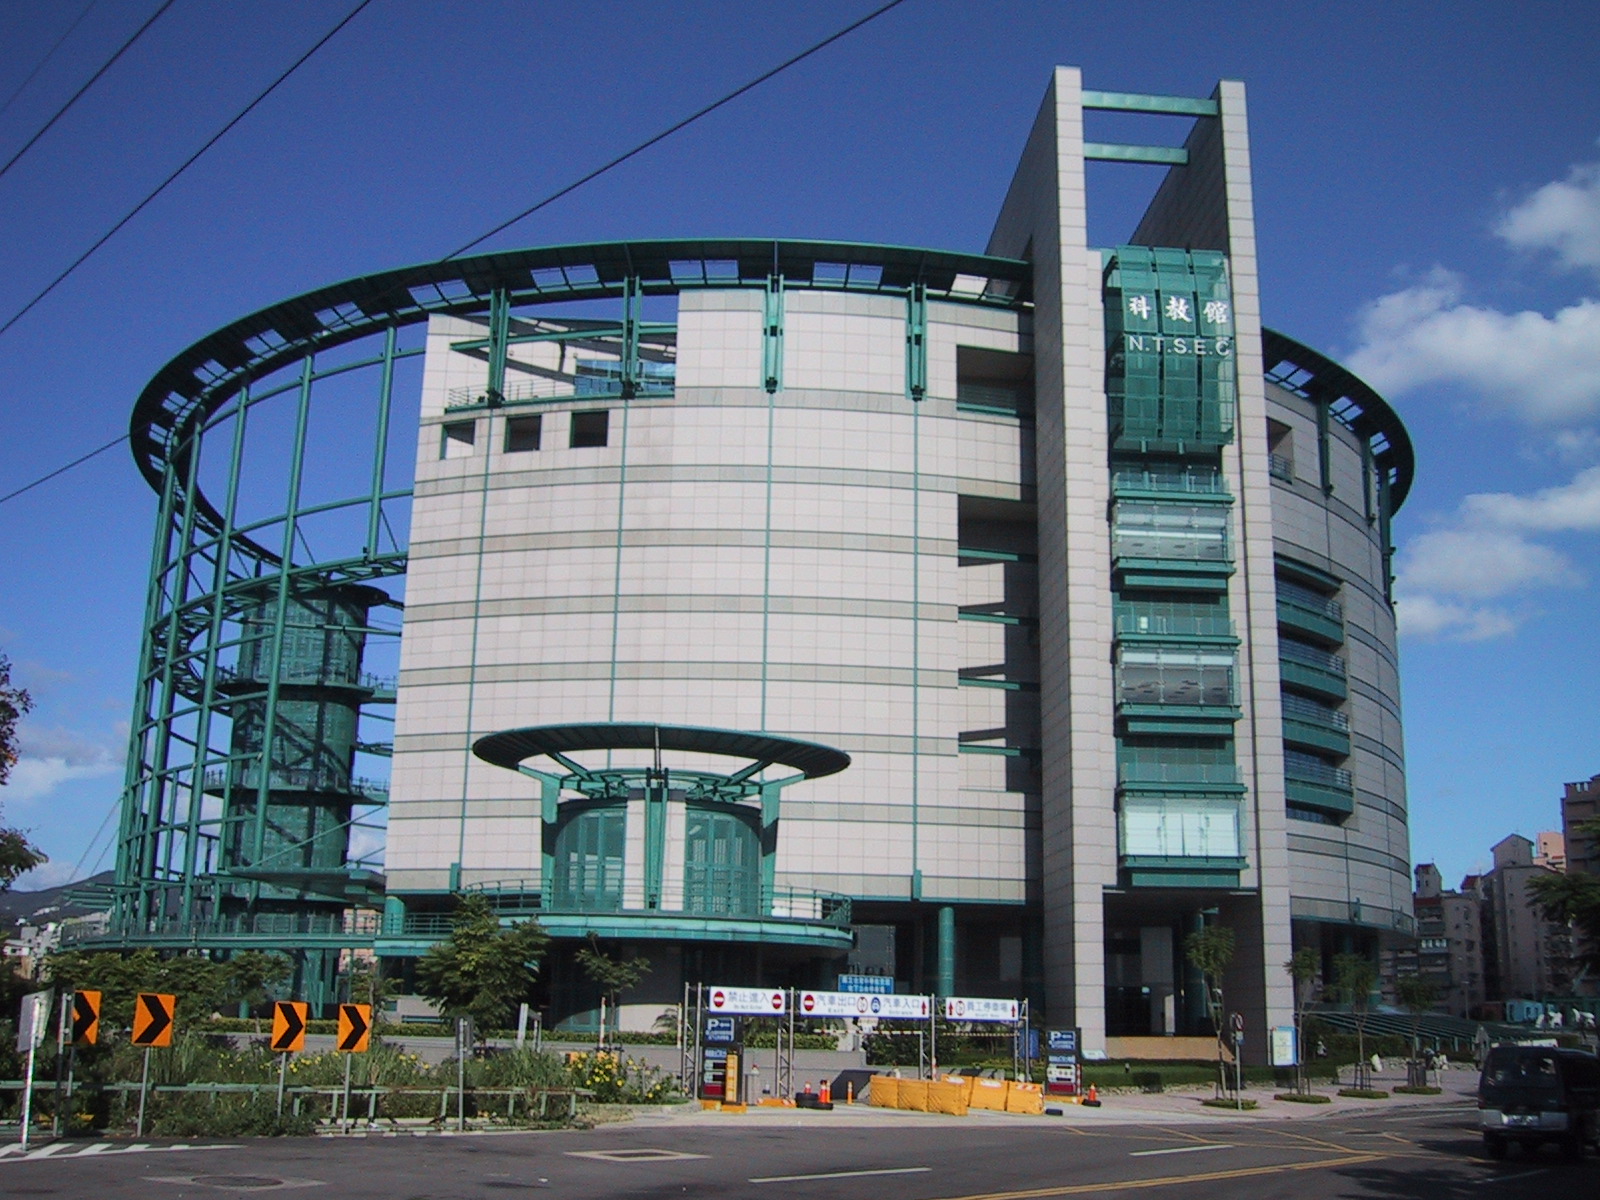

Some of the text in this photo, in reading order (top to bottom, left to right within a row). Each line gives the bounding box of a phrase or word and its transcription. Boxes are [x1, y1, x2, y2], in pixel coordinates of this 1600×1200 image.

[1129, 295, 1228, 324] 科教館
[728, 991, 769, 1003] 禁止進入
[816, 994, 856, 1007] 汽車出口
[883, 997, 919, 1009] 汽車入口
[708, 1018, 719, 1030] P
[1050, 1031, 1062, 1041] P
